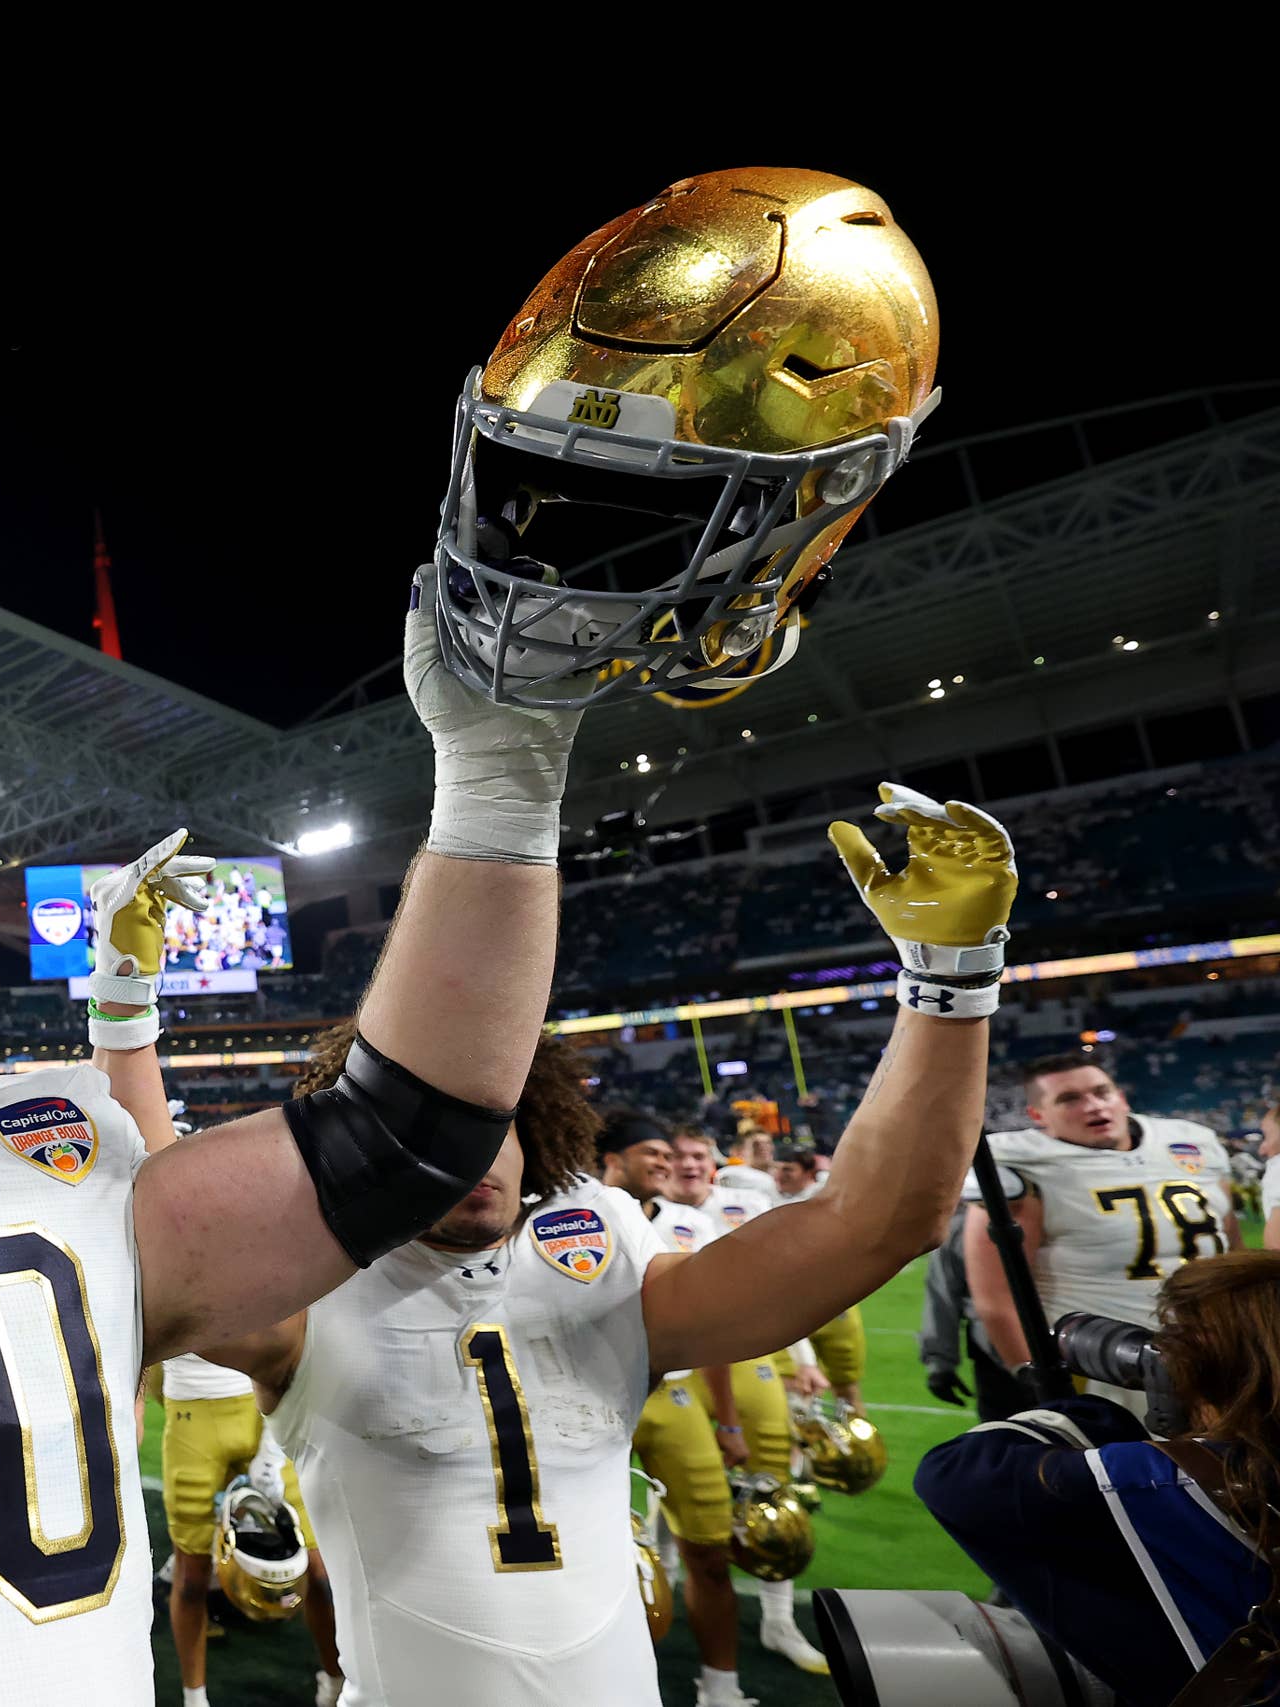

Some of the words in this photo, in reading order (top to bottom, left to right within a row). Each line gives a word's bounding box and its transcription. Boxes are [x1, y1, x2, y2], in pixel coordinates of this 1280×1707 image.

[10, 1130, 57, 1152] ORANGE
[58, 1124, 94, 1141] BOWL
[1091, 1180, 1229, 1281] 78
[459, 1323, 563, 1573] 1
